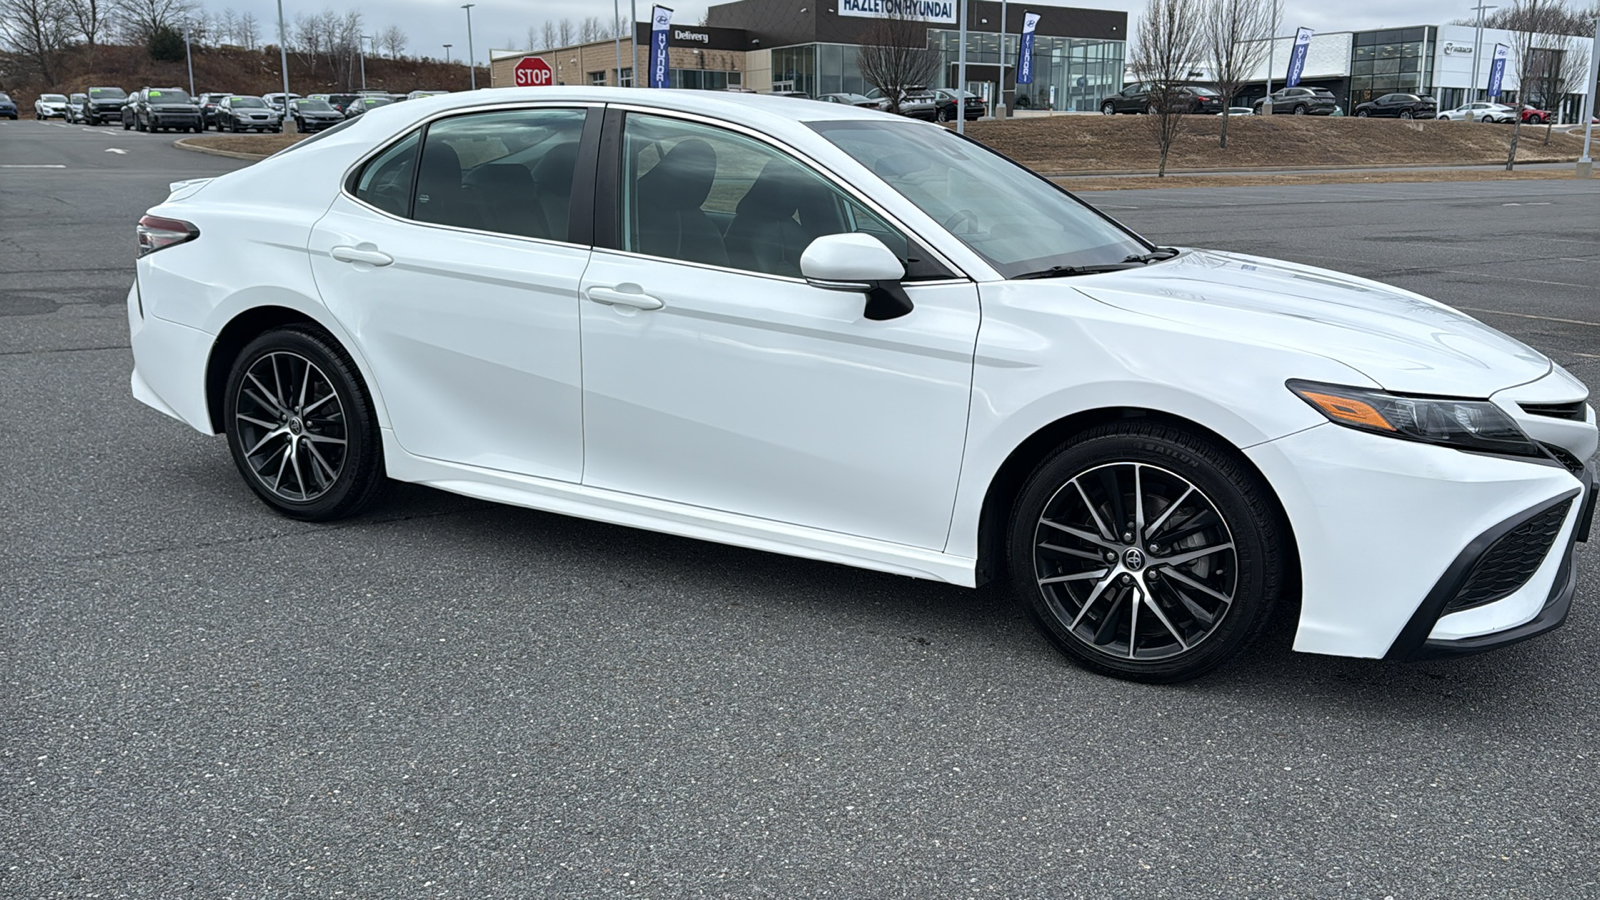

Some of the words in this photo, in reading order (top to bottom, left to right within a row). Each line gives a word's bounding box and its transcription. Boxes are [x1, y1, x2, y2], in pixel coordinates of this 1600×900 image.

[843, 0, 902, 14] HAZLETON
[903, 0, 952, 18] HYUNDAI
[674, 30, 709, 44] Delivery
[656, 33, 666, 89] HYUNDAI
[517, 69, 551, 84] STOP
[1145, 444, 1200, 468] SAILUN
